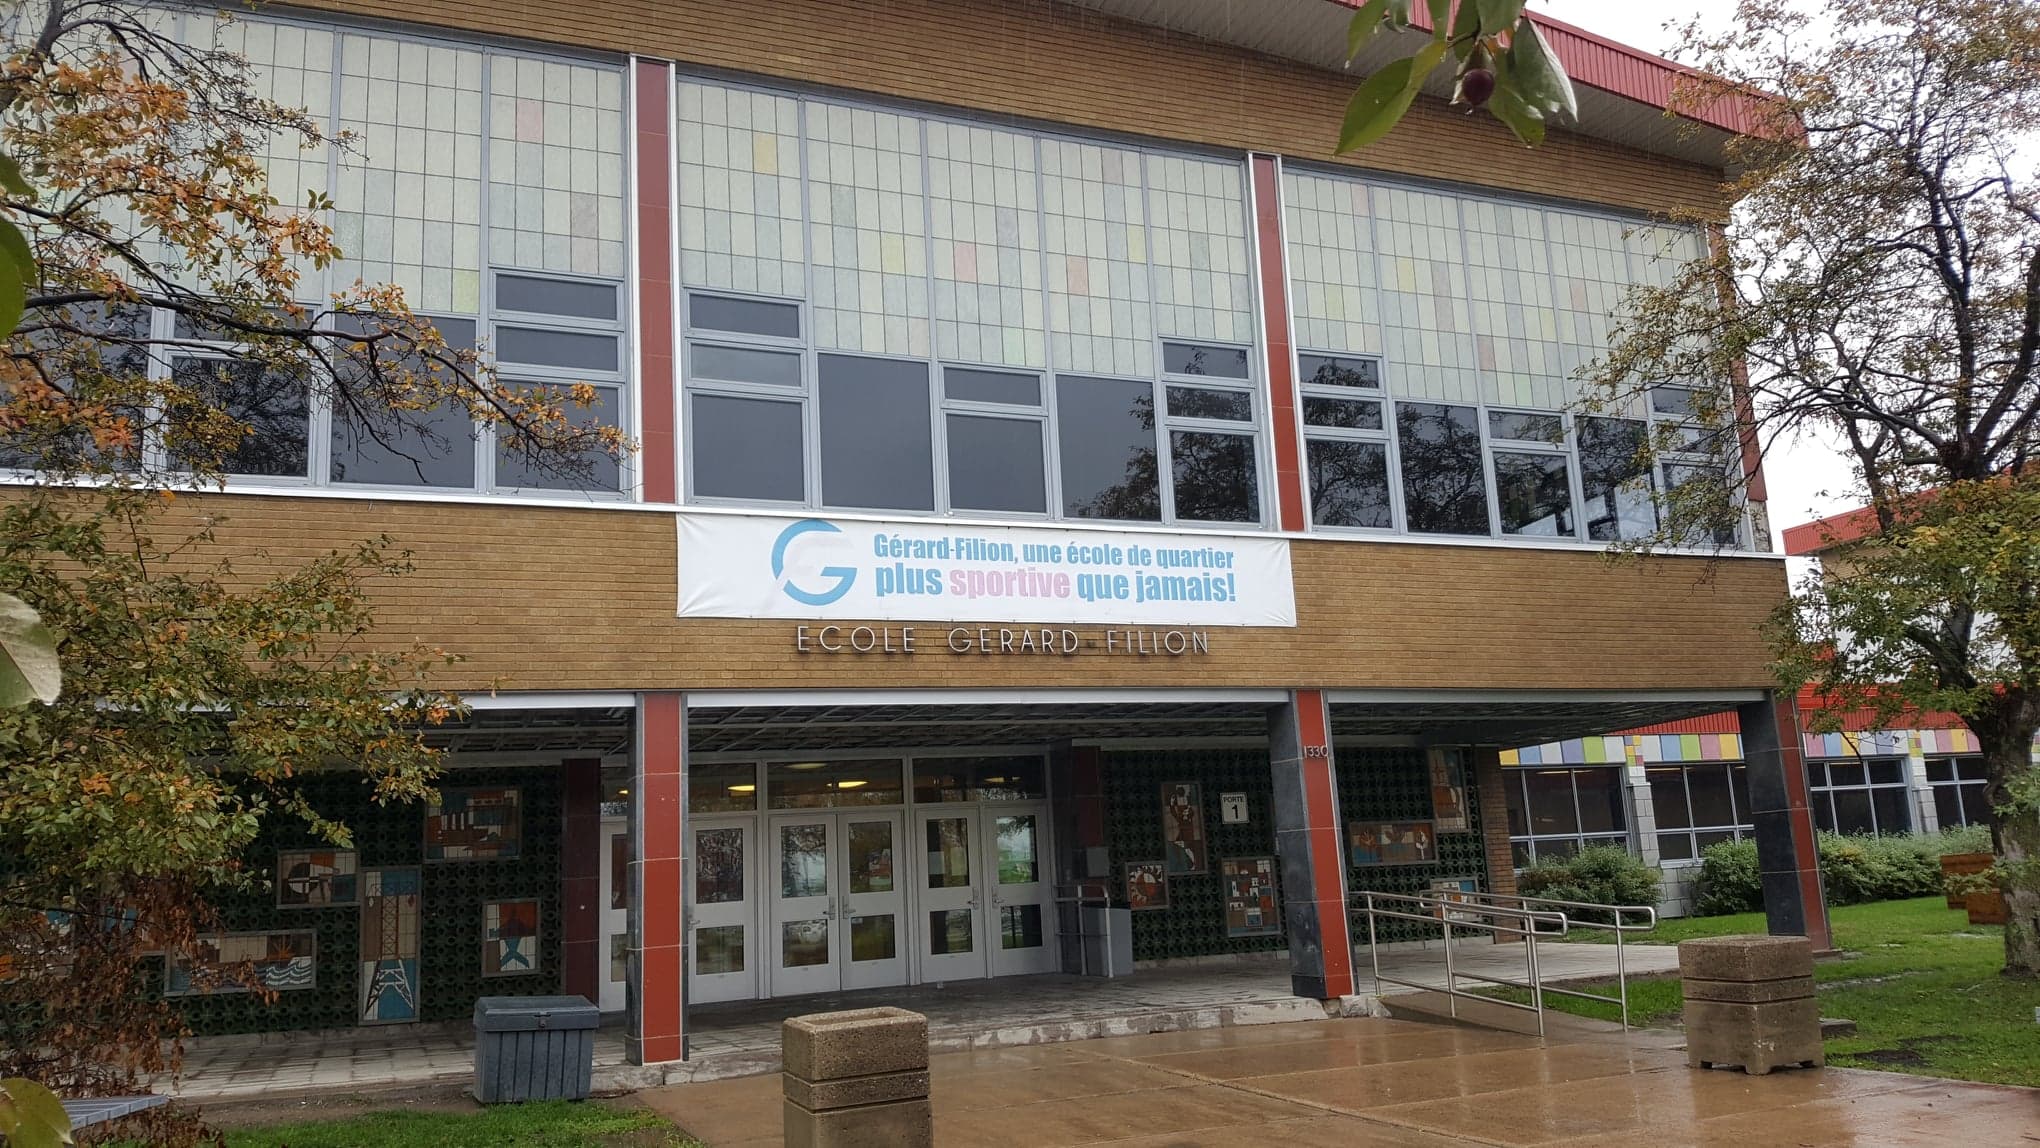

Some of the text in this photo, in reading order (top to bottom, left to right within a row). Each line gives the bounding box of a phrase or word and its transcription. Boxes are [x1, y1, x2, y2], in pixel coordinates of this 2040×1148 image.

[874, 533, 1234, 569] Gérard-Filion, une école de quartier
[876, 562, 1236, 603] plus sportive que jamais!
[797, 625, 1209, 655] ECOLE GERARD FILION
[1304, 745, 1328, 758] 1330
[1232, 804, 1239, 819] 1
